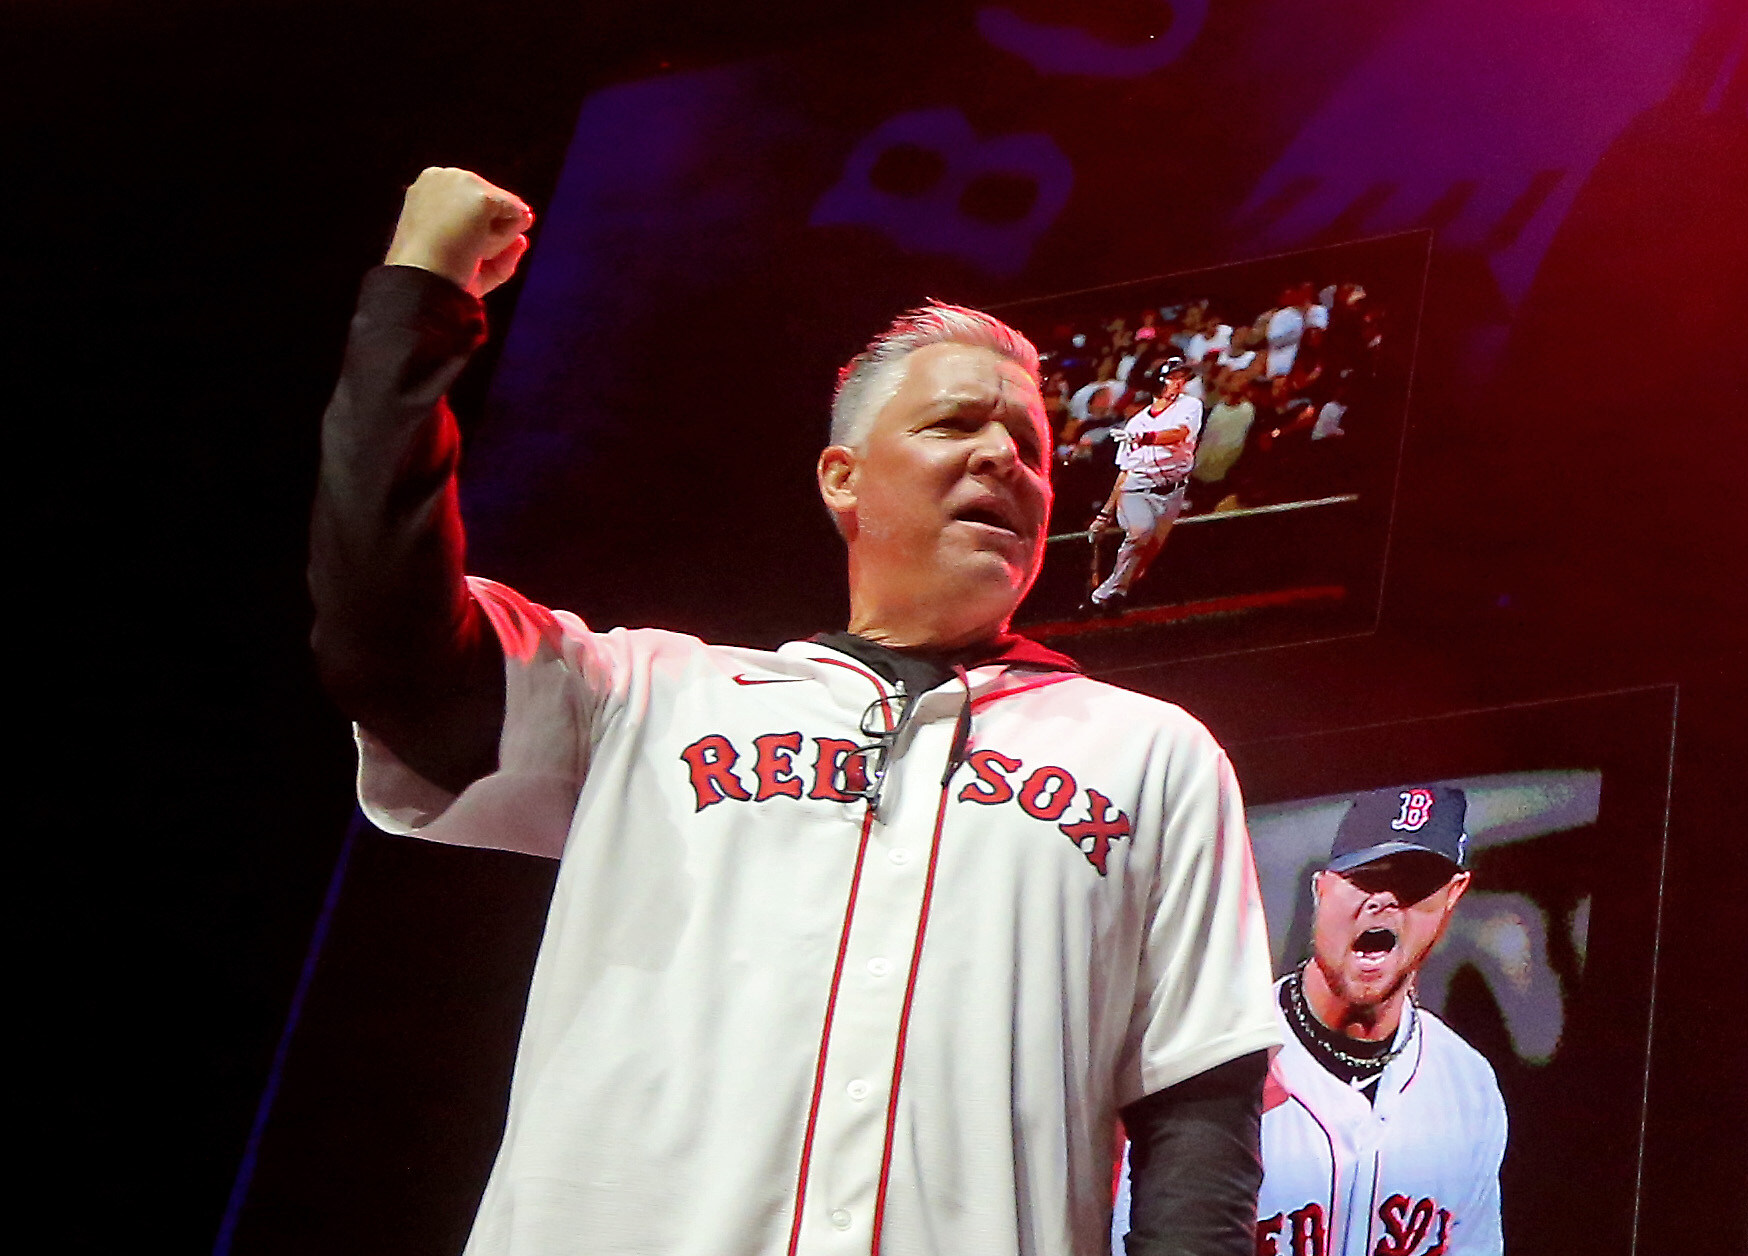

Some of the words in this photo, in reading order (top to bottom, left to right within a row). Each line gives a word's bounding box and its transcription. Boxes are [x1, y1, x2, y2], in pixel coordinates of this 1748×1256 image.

[681, 730, 873, 814] RED
[958, 749, 1132, 877] SOX
[1391, 788, 1435, 832] B
